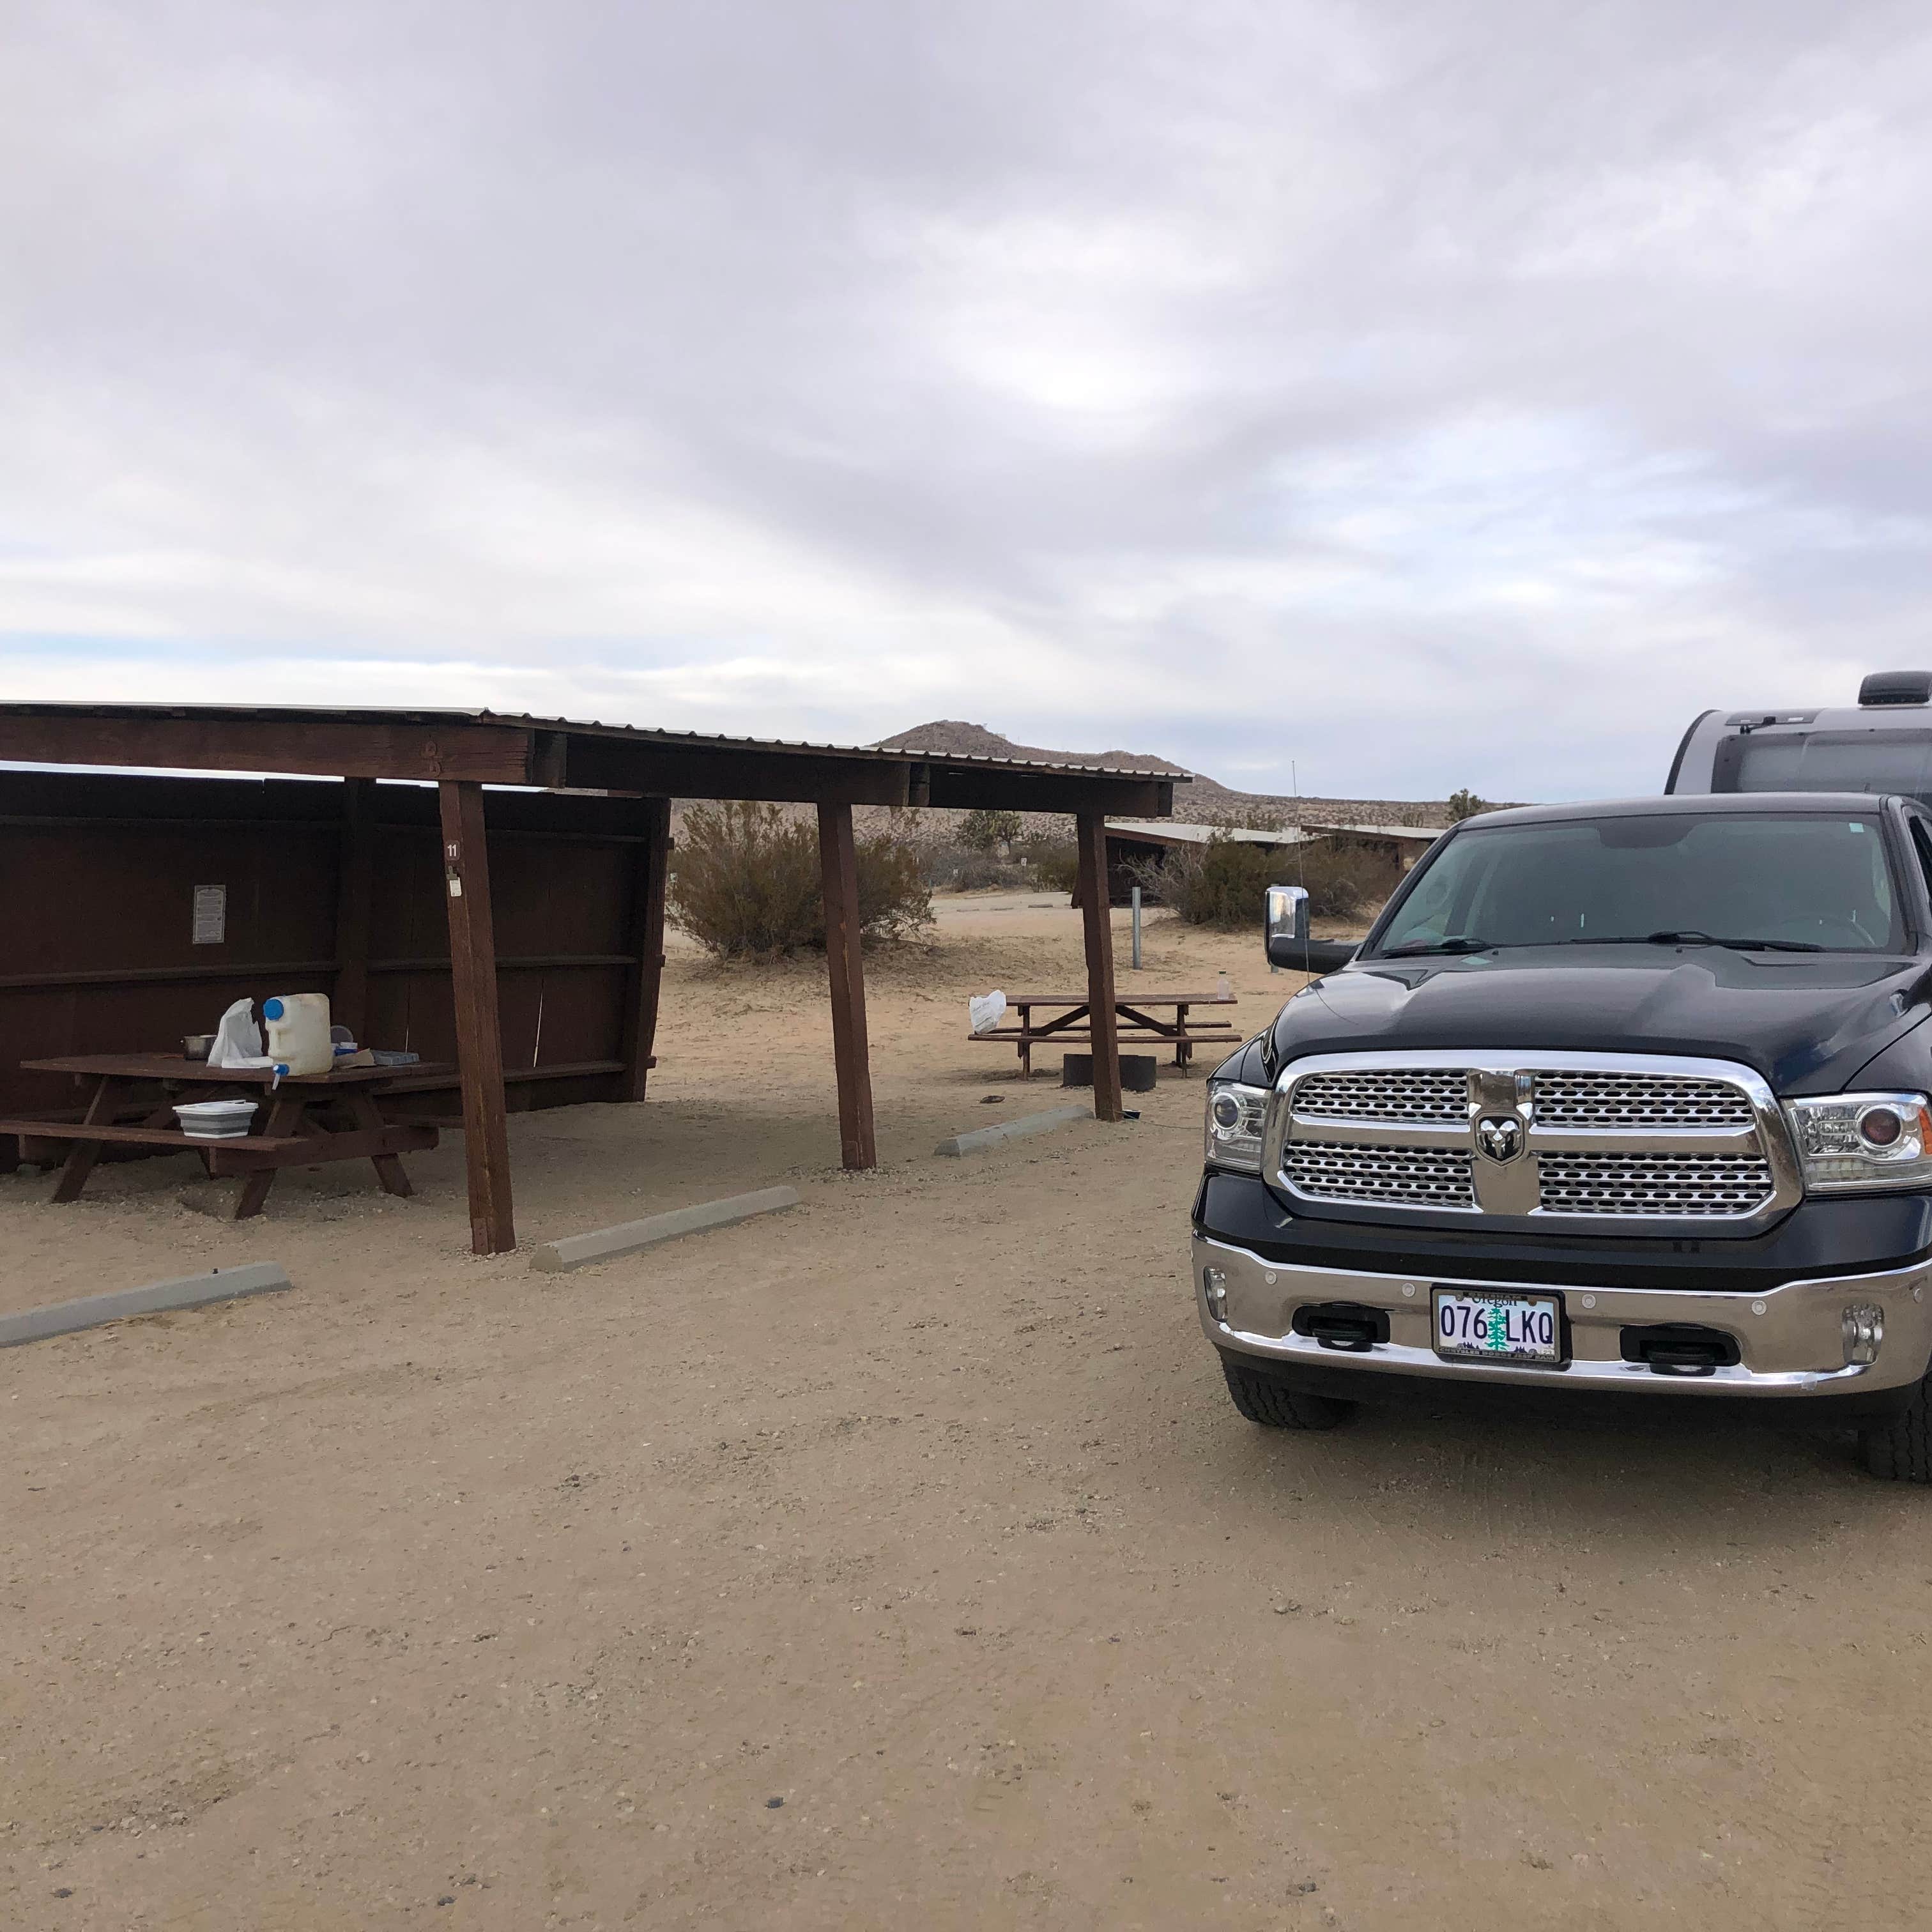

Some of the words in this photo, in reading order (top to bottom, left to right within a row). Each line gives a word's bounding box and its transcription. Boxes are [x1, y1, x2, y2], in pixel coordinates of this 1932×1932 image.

[447, 844, 457, 857] 11
[1472, 1297, 1517, 1308] Oregon
[1441, 1305, 1488, 1339] 076
[1505, 1308, 1553, 1344] LKQ
